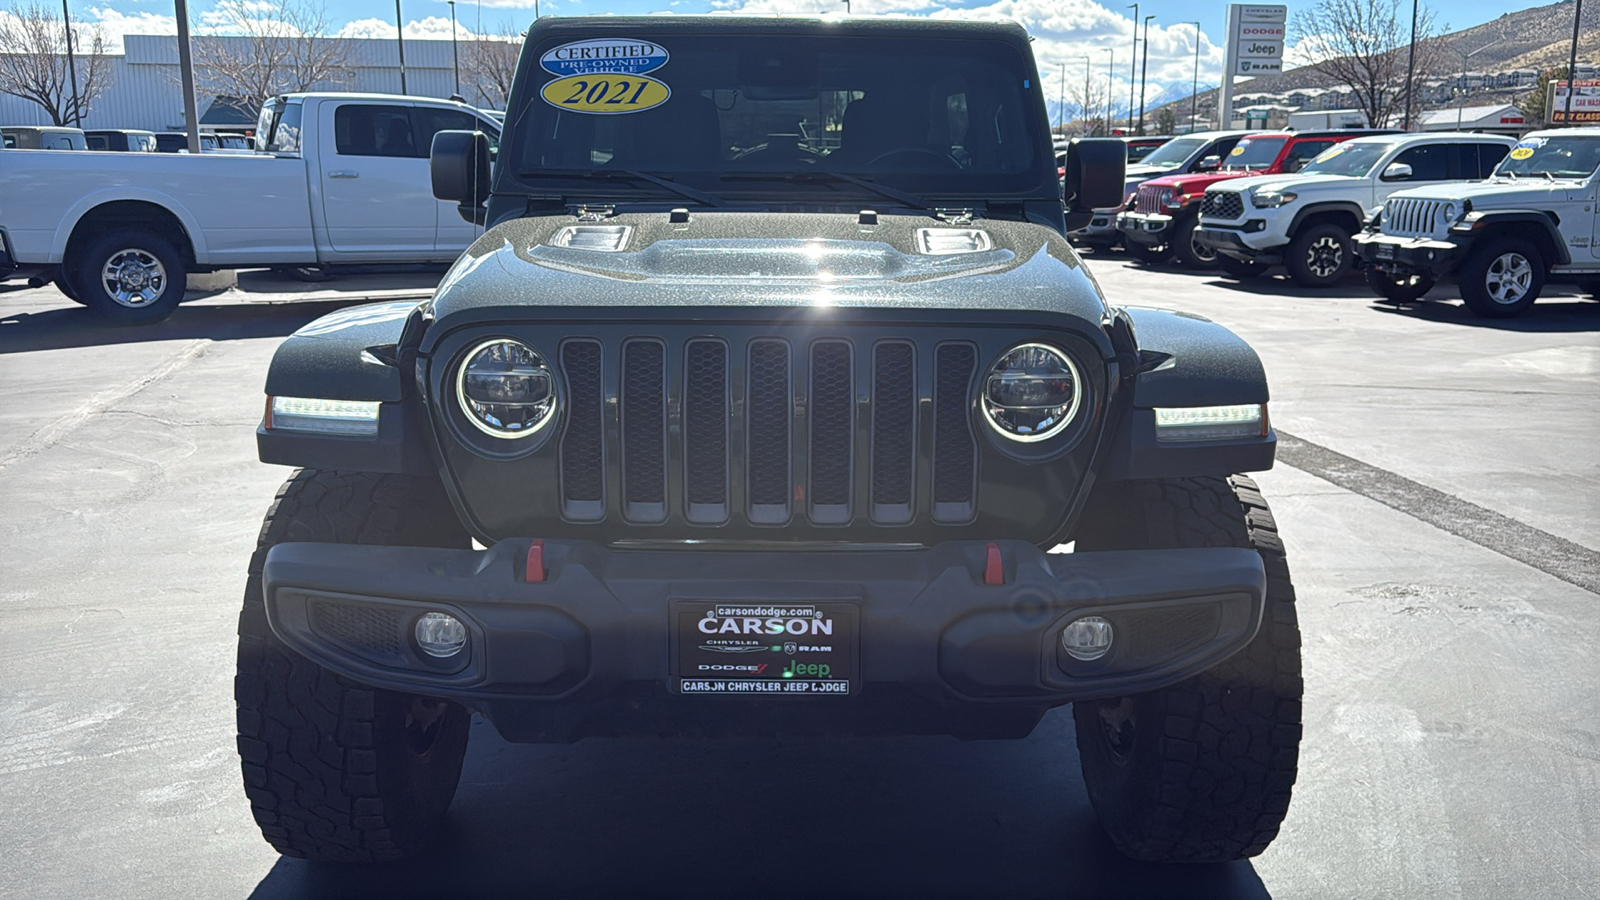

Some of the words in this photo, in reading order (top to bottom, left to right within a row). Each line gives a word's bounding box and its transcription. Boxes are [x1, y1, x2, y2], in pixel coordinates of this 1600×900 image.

[555, 45, 654, 60] CERTIFIED
[1248, 43, 1276, 55] Jeep
[560, 58, 650, 68] PRE-OWNED
[574, 66, 638, 74] VEHICLE
[562, 80, 649, 105] 2021
[1554, 112, 1575, 121] FAT
[718, 606, 813, 617] carsondodge.com
[697, 617, 833, 635] CARSON
[783, 659, 830, 677] Jeep
[728, 681, 781, 692] CHRYSLER
[784, 682, 809, 692] JEEP
